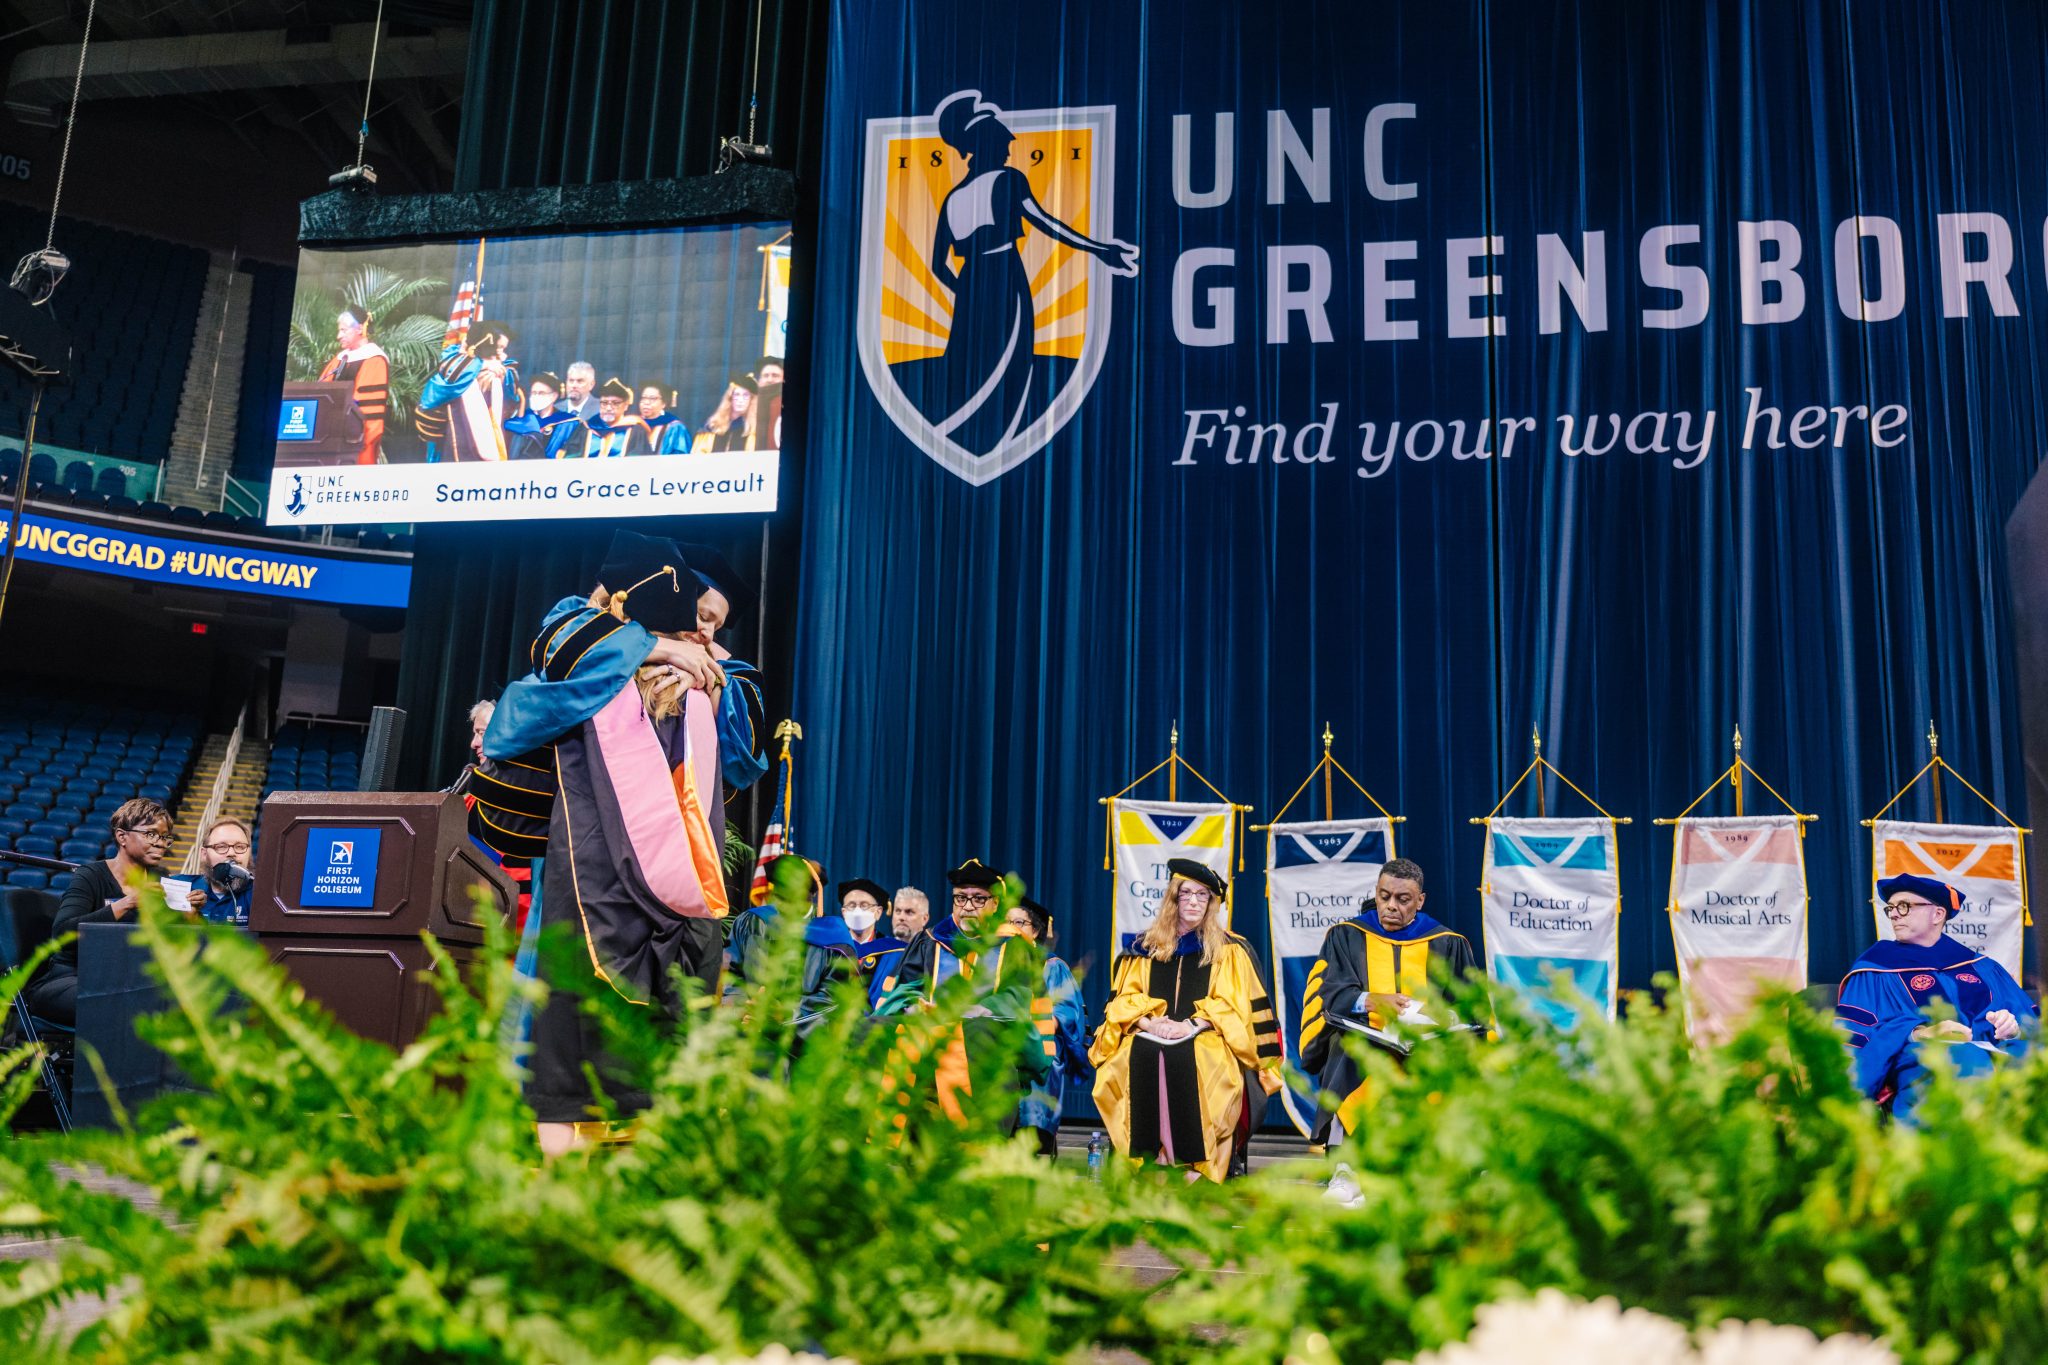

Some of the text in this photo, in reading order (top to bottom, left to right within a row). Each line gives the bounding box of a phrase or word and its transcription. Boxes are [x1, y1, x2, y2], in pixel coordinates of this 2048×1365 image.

[1172, 103, 1418, 209] UNC
[0, 153, 31, 180] 05
[1171, 211, 2048, 348] GREENSBOR
[1172, 387, 1908, 478] Find your way here
[317, 475, 345, 488] UNC
[435, 472, 765, 503] Samantha Grace Levreault
[316, 488, 410, 504] GREENSBORO
[170, 550, 319, 589] #UNCGWAY
[1161, 819, 1183, 828] 1920
[1318, 837, 1342, 846] 1963
[317, 875, 361, 885] HORIZON
[326, 866, 353, 875] FIRST
[313, 885, 363, 894] COLISEUM
[1295, 890, 1353, 908] Doctor
[1512, 891, 1591, 914] Doctor of
[1705, 890, 1779, 909] Doctor of
[1978, 897, 1995, 916] of
[1509, 911, 1593, 931] Education
[1690, 908, 1793, 925] Musical Arts
[1945, 918, 1988, 938] rsing
